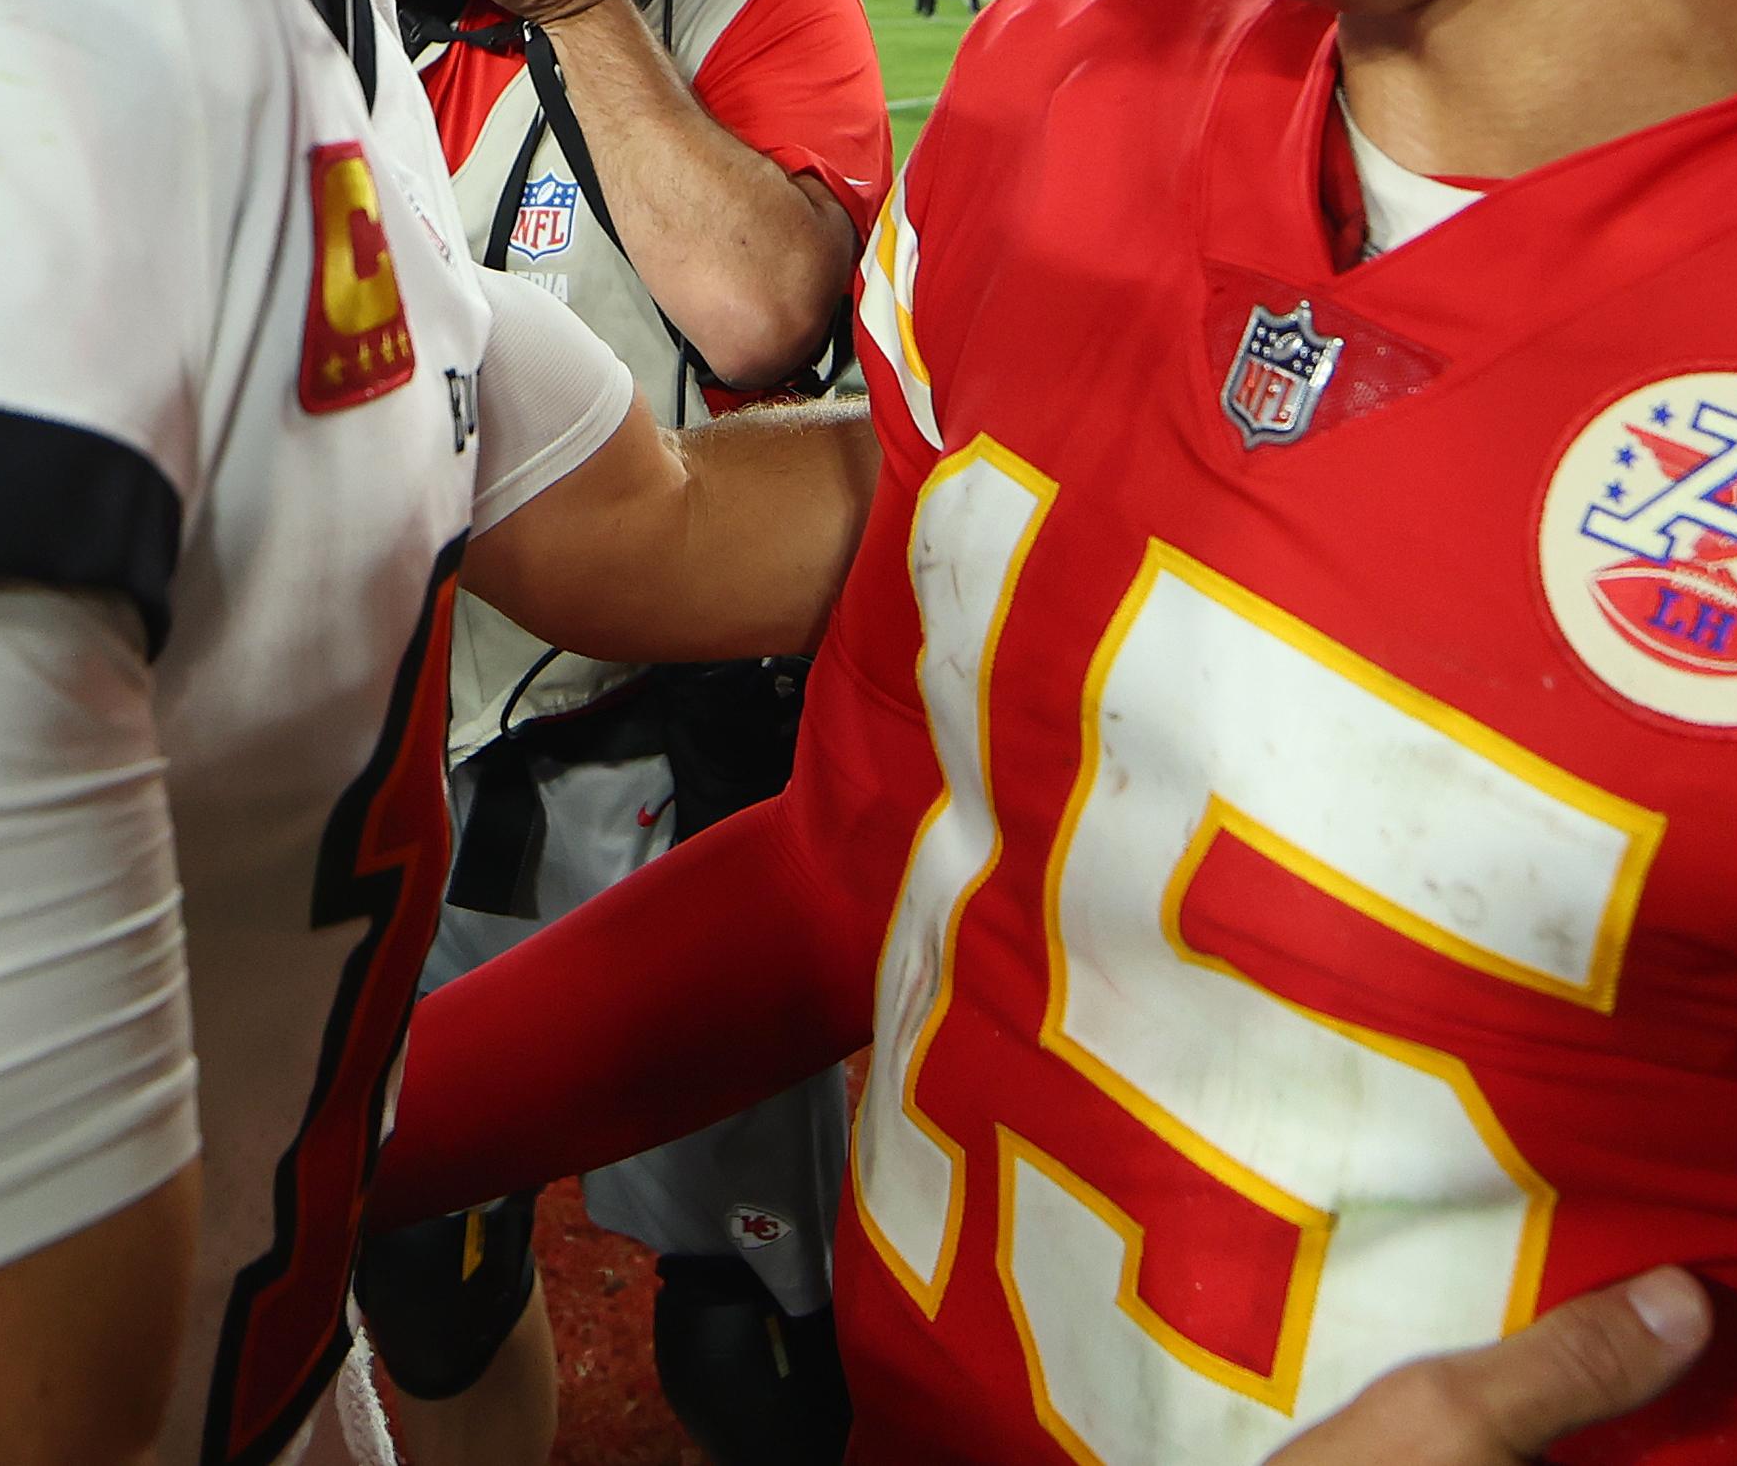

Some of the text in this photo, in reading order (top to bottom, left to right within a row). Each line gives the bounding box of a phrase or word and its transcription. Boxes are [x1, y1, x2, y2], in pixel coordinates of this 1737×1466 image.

[322, 155, 400, 333] C
[511, 209, 565, 249] NFL
[1647, 587, 1737, 653] LH
[851, 431, 1667, 1466] 15
